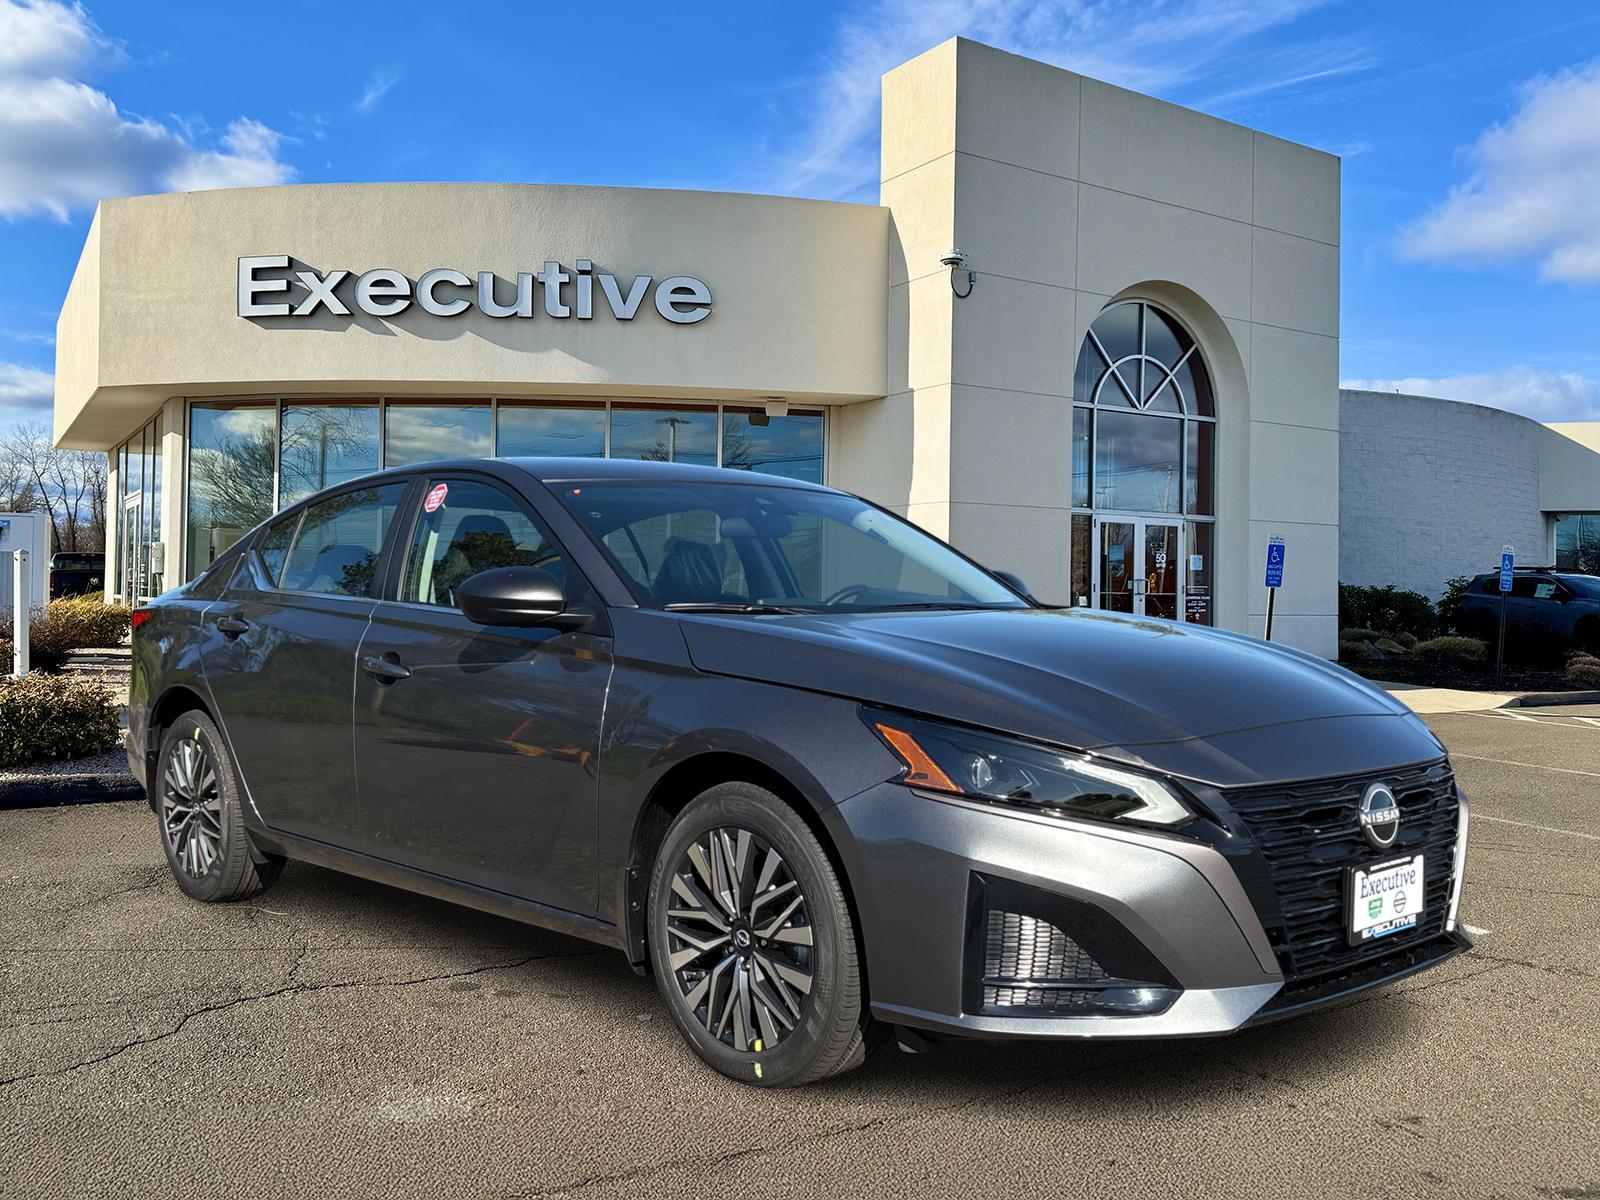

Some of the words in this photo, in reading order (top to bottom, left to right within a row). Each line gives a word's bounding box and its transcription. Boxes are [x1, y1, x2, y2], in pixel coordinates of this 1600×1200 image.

[237, 254, 714, 325] Executive
[1155, 553, 1167, 563] 50
[1361, 808, 1400, 825] NISSAN
[1360, 867, 1416, 899] Executive
[1362, 914, 1416, 938] EXECUTIVE
